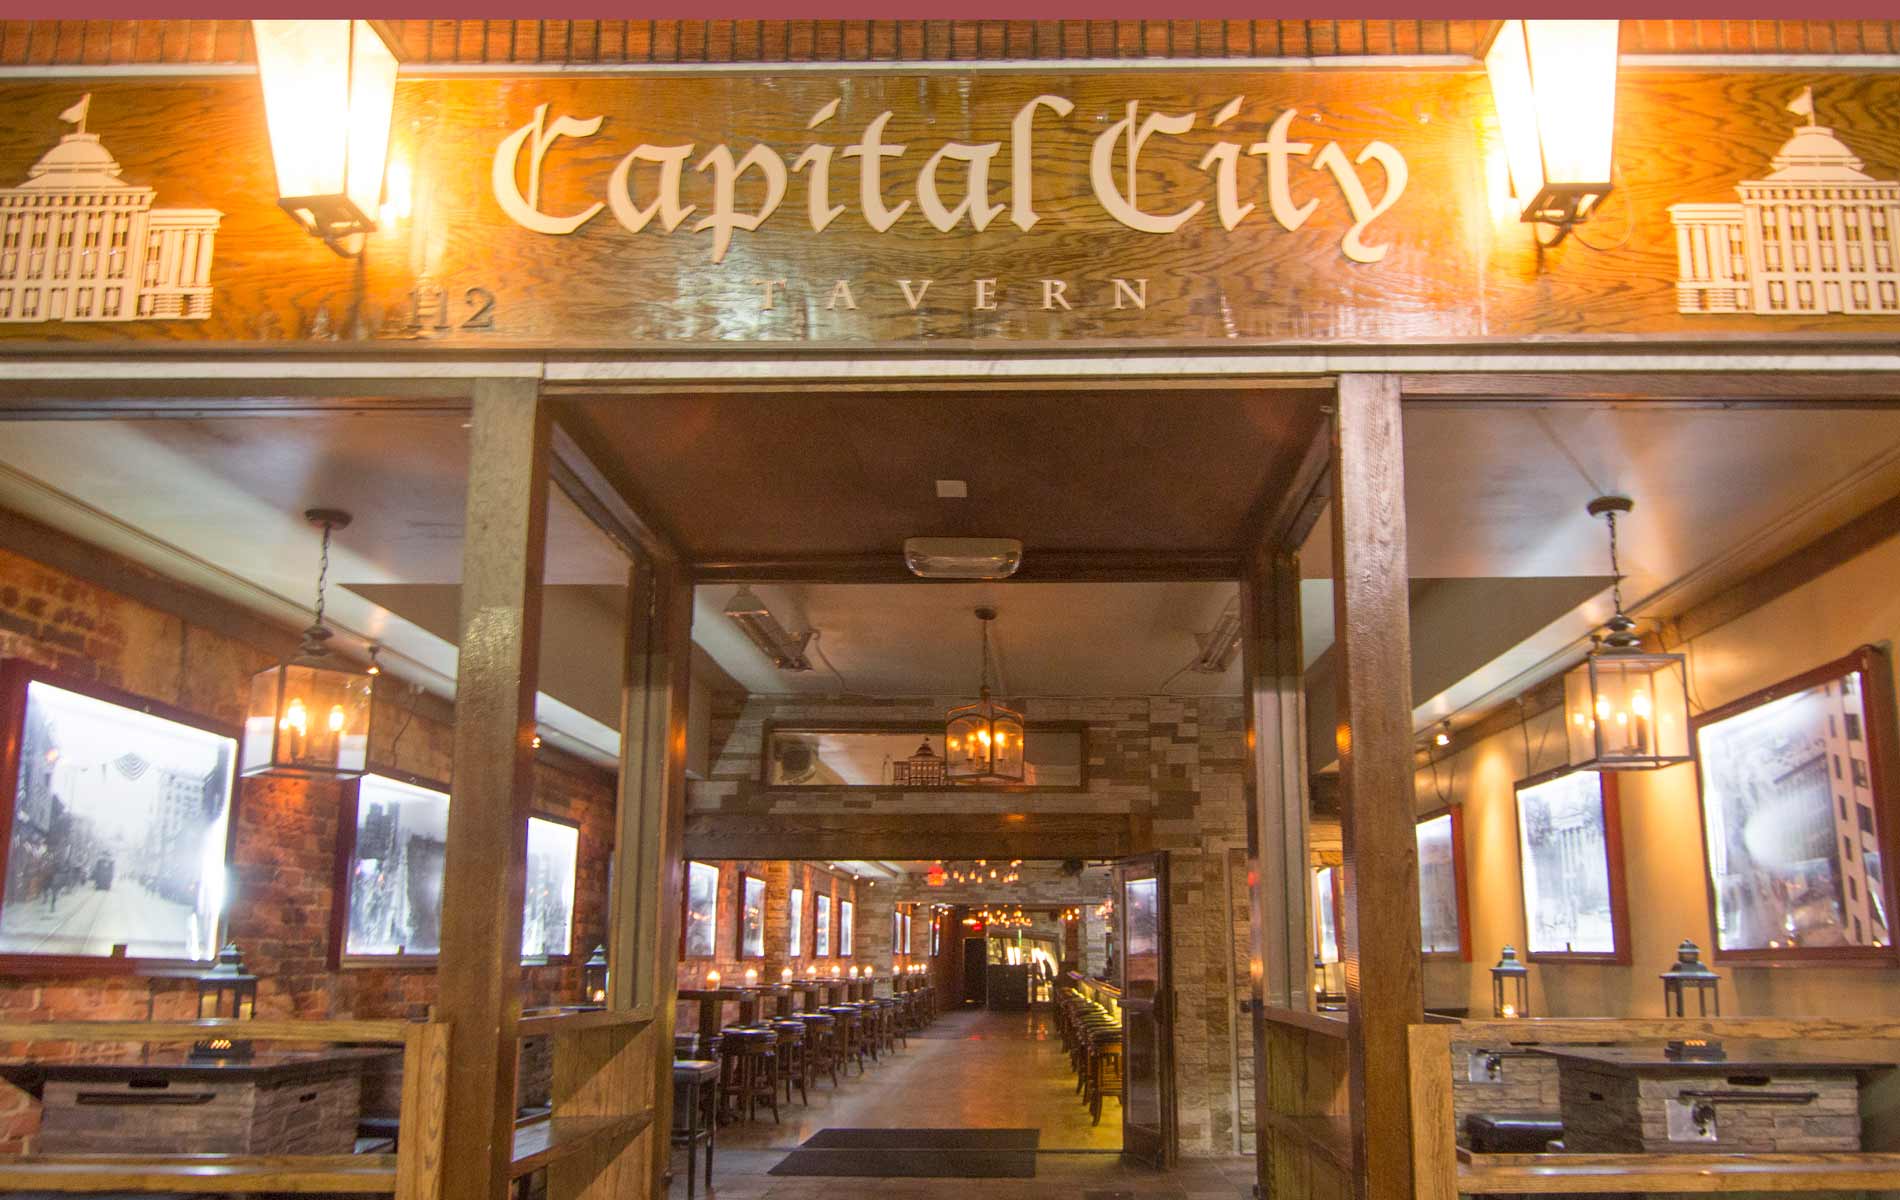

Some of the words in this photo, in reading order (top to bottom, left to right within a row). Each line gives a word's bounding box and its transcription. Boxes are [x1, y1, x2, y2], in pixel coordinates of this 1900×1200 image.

[492, 95, 1075, 264] Capital
[1090, 94, 1409, 263] City
[407, 287, 495, 331] 112
[752, 278, 1148, 311] TAVERN
